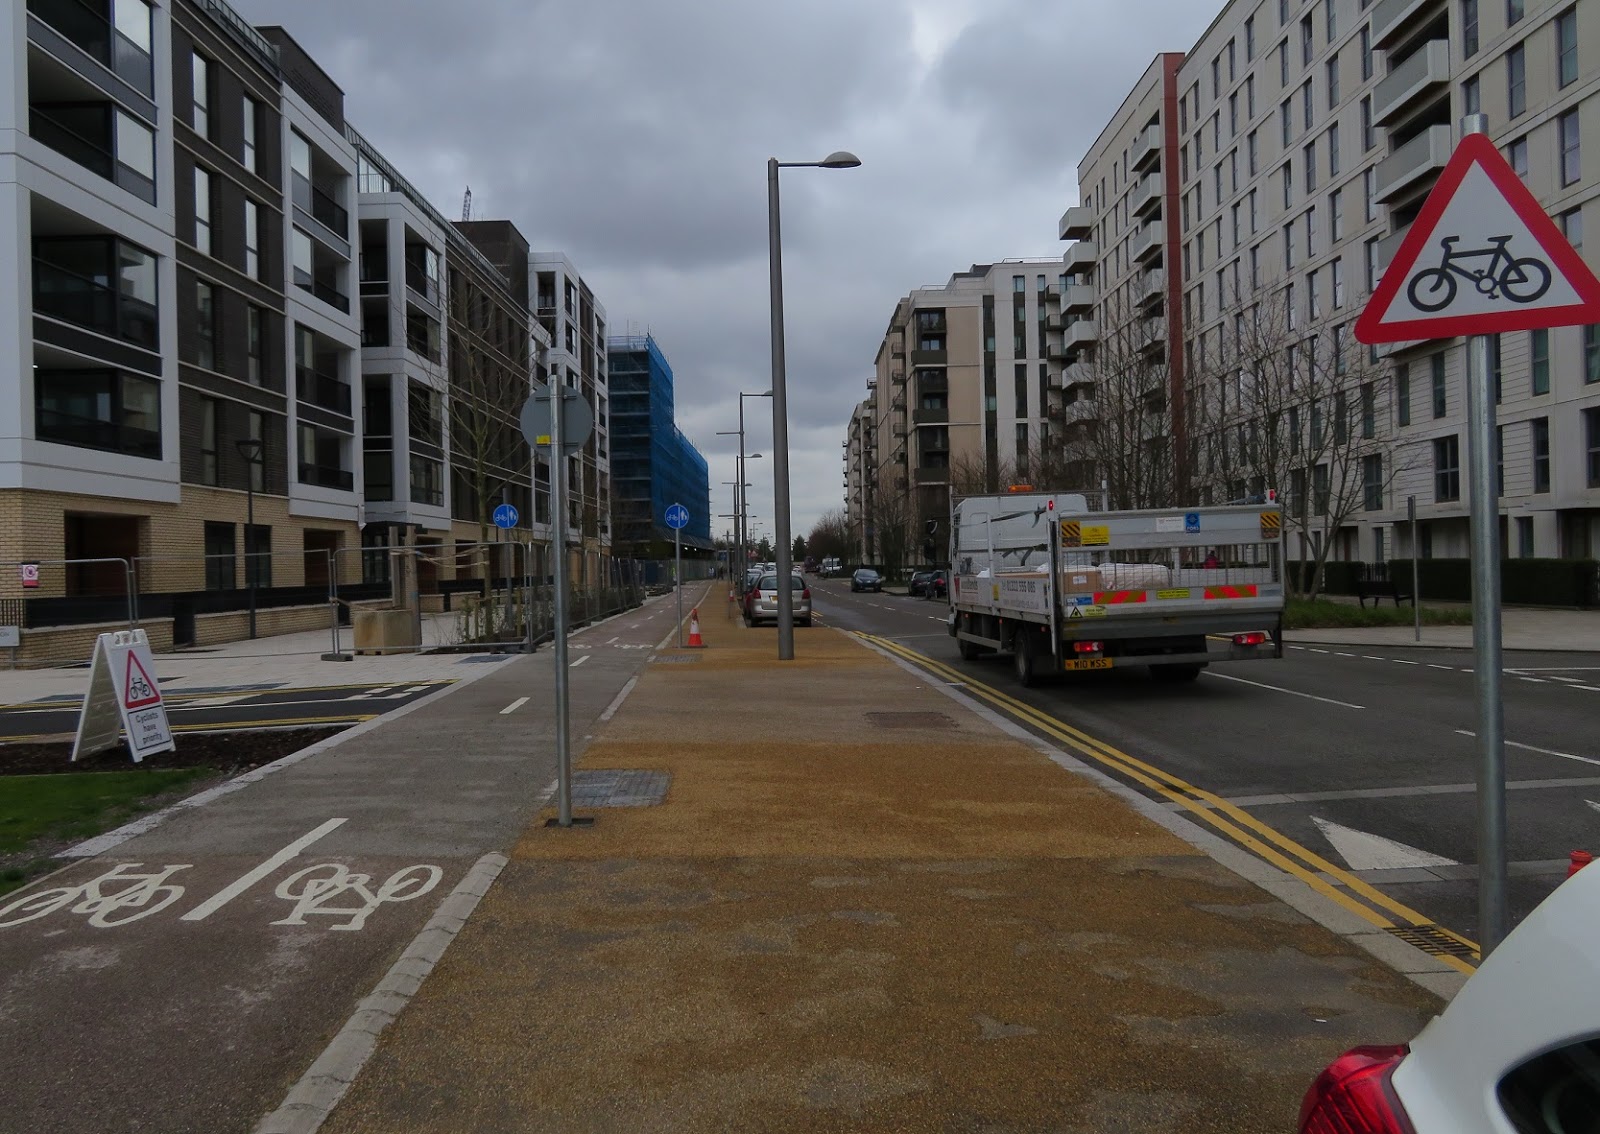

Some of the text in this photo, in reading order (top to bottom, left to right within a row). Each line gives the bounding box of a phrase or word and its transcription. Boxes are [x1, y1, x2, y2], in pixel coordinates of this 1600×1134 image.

[135, 712, 159, 724] Cyclists
[142, 724, 157, 732] have
[142, 732, 163, 745] priority
